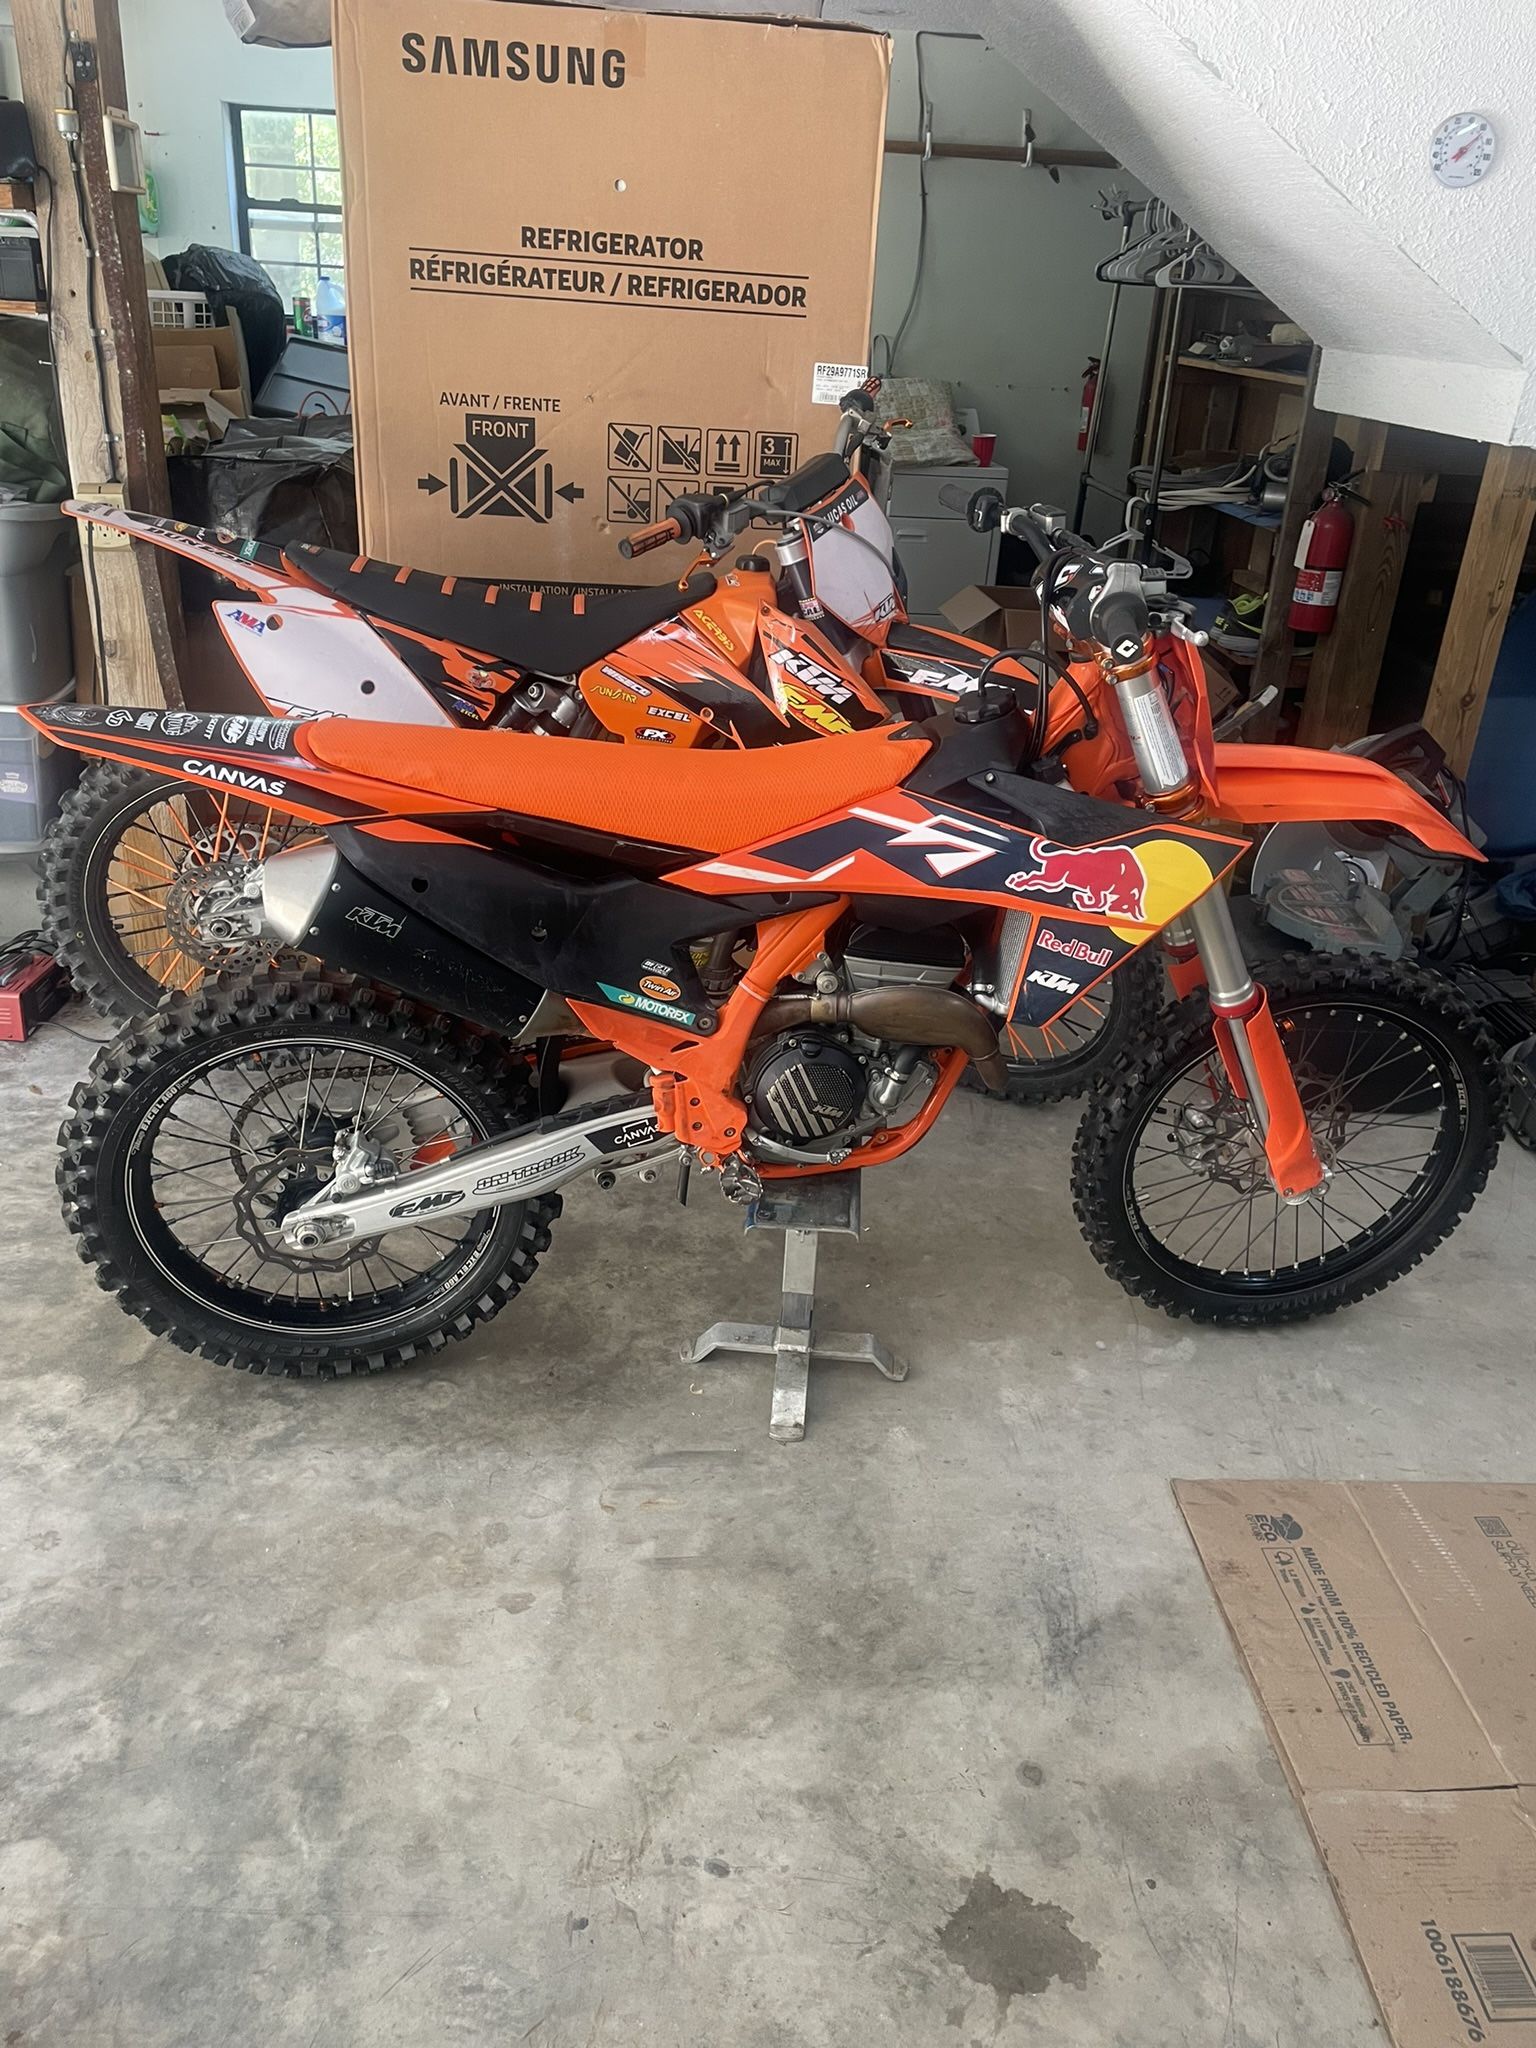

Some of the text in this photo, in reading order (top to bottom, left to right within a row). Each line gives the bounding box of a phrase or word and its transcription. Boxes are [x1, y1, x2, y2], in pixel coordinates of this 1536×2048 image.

[401, 32, 627, 89] SAMSUNG
[521, 226, 704, 261] REFRIGERATOR
[409, 254, 807, 308] RÉFRIGÉRATEUR / REFRIGERADOR
[816, 365, 866, 379] RF29A9771SR
[439, 391, 561, 413] AVANT / FRENTE
[471, 420, 529, 440] FRONT
[764, 437, 775, 454] 3
[763, 457, 782, 467] MAX
[823, 494, 859, 527] LUCAS OIL
[146, 527, 255, 567] DUNLOP
[225, 609, 265, 633] AMA
[692, 608, 735, 652] ACERBIS
[601, 665, 652, 696] WISECO
[770, 648, 853, 705] KTM
[590, 685, 637, 703] SUNSTAR
[647, 706, 691, 723] EXCEL
[642, 728, 669, 740] FX
[183, 759, 285, 796] CANVAS
[345, 906, 406, 939] KTM
[643, 980, 679, 997] Twin Air
[1026, 970, 1080, 995] KTM
[634, 996, 691, 1024] MOTOREX
[140, 1101, 164, 1131] EXCEL
[161, 1086, 178, 1104] A60
[813, 1103, 844, 1118] KTM
[391, 1191, 465, 1217] FMF
[457, 1250, 480, 1275] EXCEL
[444, 1274, 459, 1289] A60
[1254, 1514, 1278, 1542] ECO
[1491, 1540, 1525, 1579] SUPPLY
[1301, 1547, 1326, 1576] MADE
[1317, 1578, 1343, 1606] FROM
[1335, 1610, 1359, 1640] 100%
[1351, 1642, 1390, 1698] RECYCLED
[1421, 1919, 1486, 2043] 1006188676
